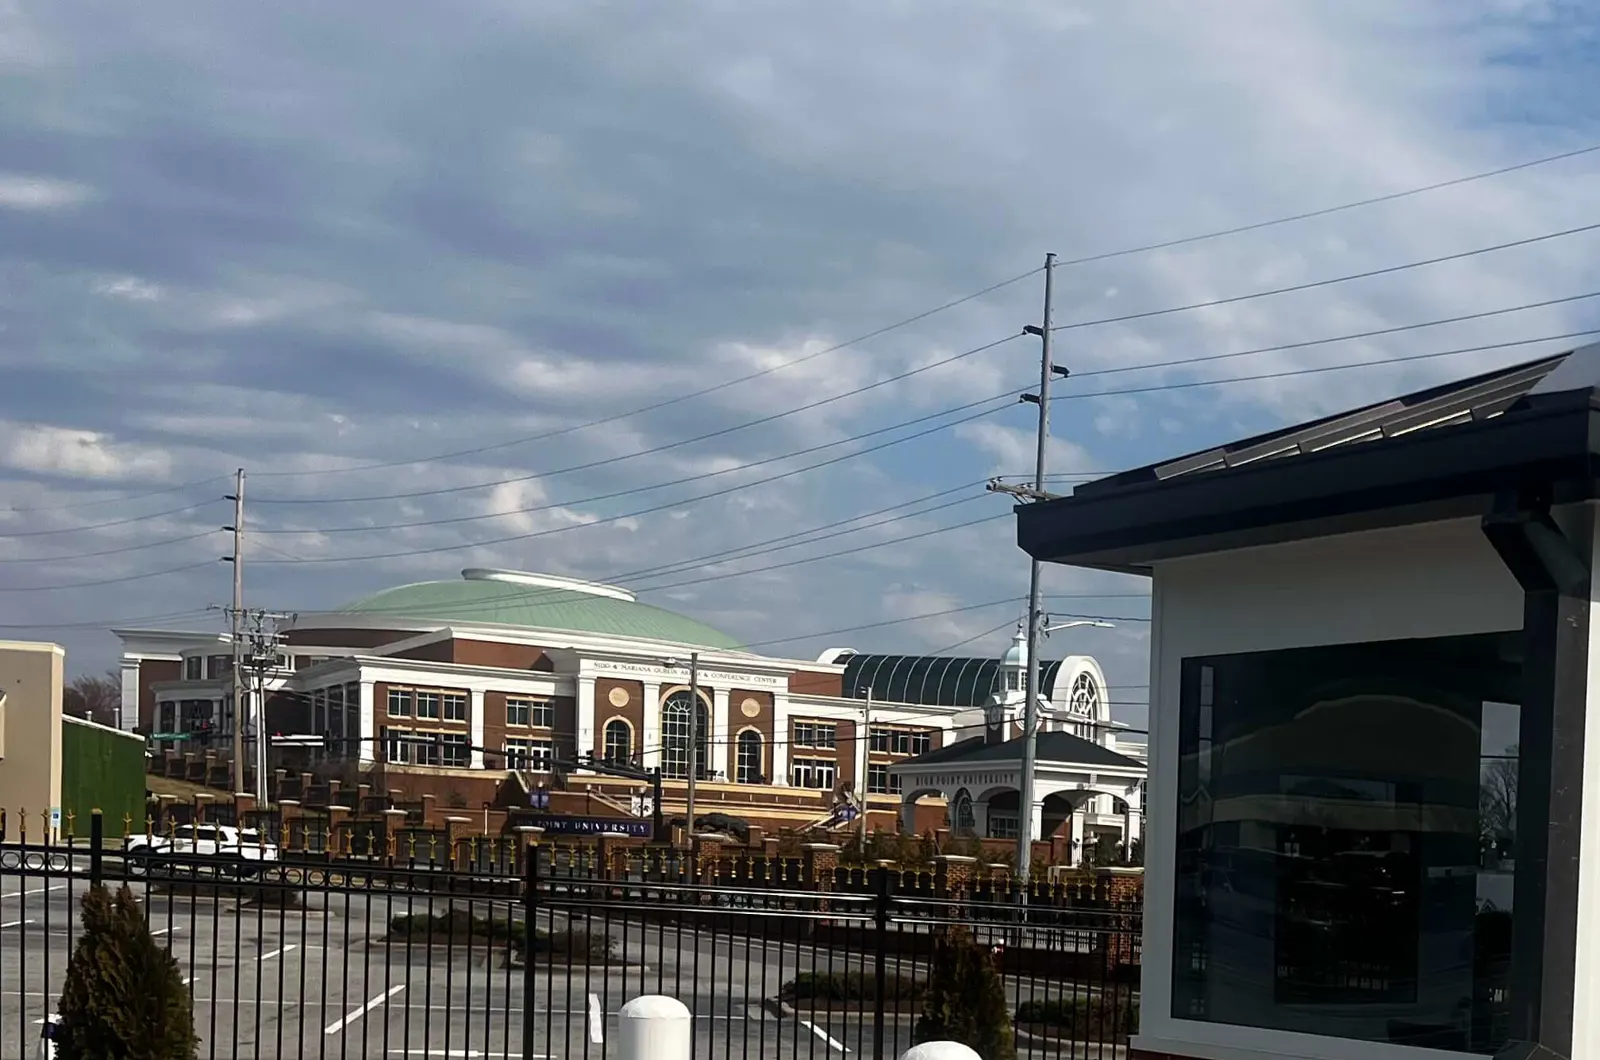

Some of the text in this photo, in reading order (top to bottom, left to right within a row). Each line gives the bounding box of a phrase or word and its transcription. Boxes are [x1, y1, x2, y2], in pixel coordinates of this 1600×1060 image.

[710, 672, 751, 682] CONFERENCE
[753, 676, 777, 684] CENTER
[574, 821, 648, 833] UNIVERSITY
